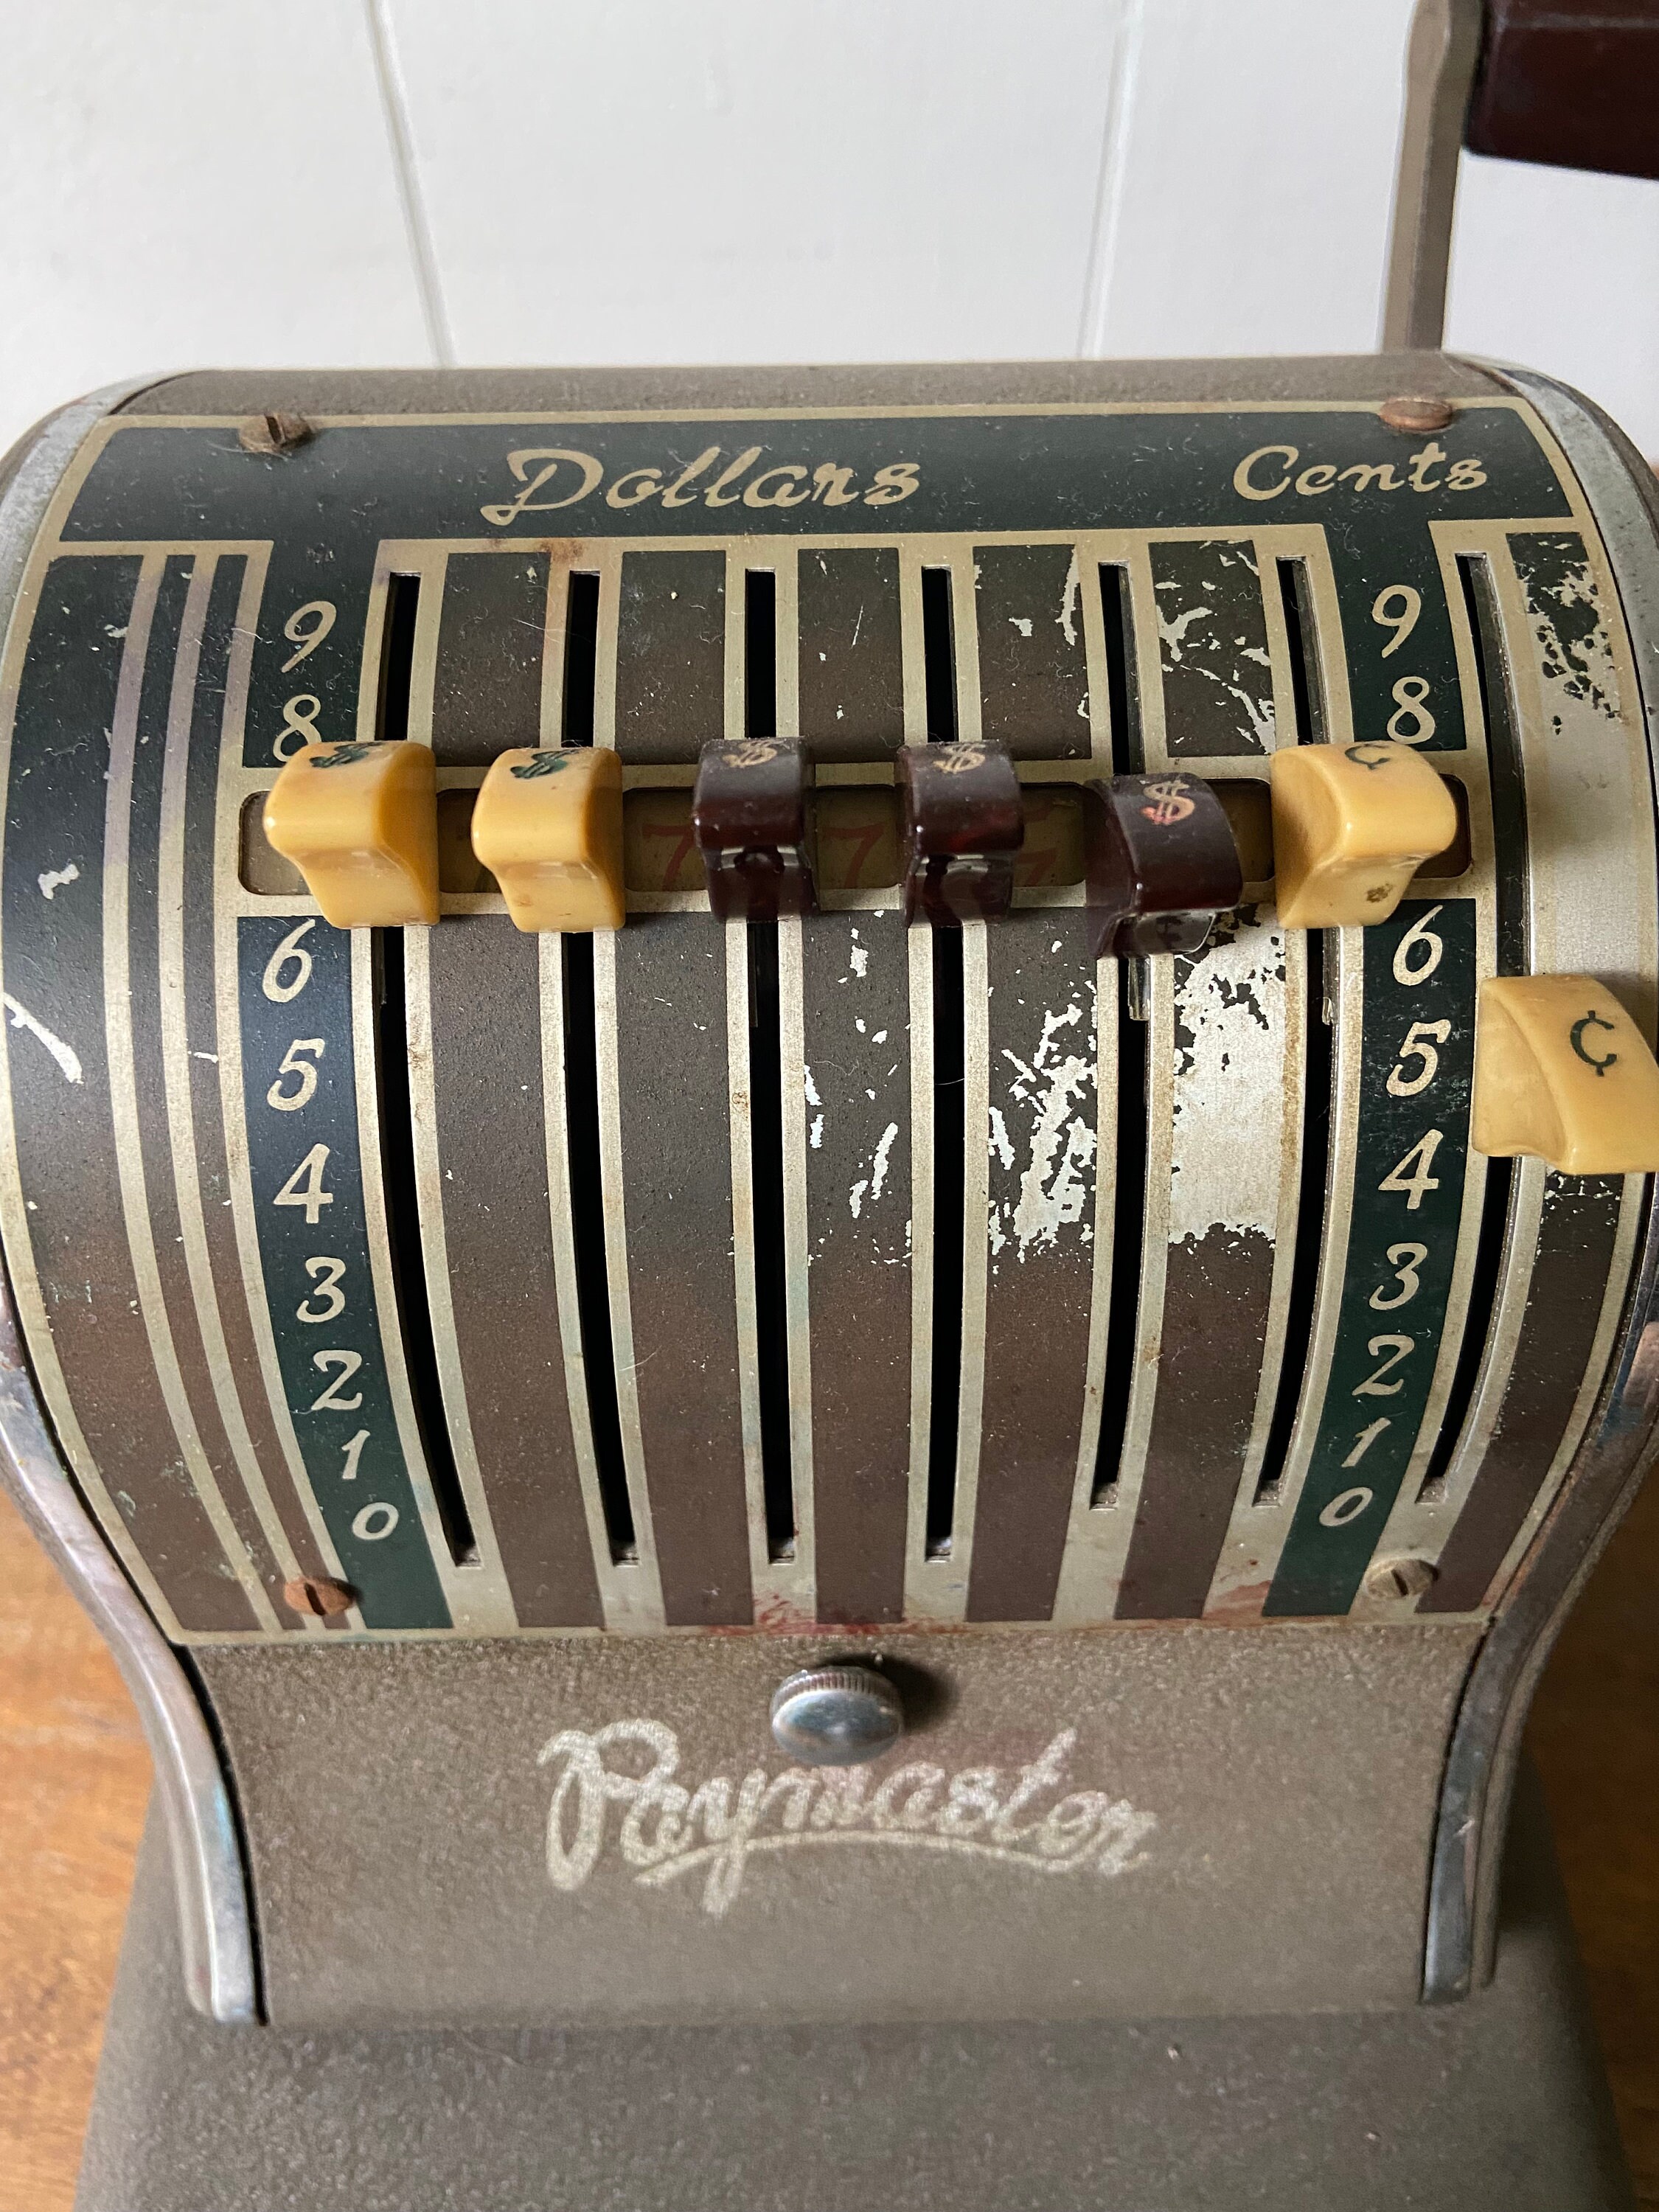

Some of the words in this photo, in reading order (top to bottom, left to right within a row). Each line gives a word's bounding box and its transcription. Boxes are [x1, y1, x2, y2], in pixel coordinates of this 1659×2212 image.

[480, 445, 920, 526] Dollars
[1233, 442, 1487, 501] Cents
[281, 600, 337, 673] 9
[1371, 584, 1422, 658] 9
[272, 694, 321, 762] 8
[1387, 676, 1436, 744] 8
[1141, 779, 1195, 826] $
[641, 824, 696, 891] 7
[824, 824, 886, 889] 7
[262, 919, 316, 1003] 6
[1392, 905, 1443, 986] 6
[266, 1038, 325, 1111] 5
[1385, 1019, 1452, 1096] 5
[274, 1143, 333, 1224] 4
[1377, 1129, 1444, 1210] 4
[296, 1256, 346, 1323] 3
[1368, 1242, 1427, 1310] 3
[311, 1349, 362, 1411] 2
[1352, 1335, 1415, 1396] 2
[341, 1429, 371, 1480] 1
[1340, 1417, 1391, 1467] 1
[352, 1502, 399, 1540] 0
[1318, 1486, 1374, 1526] 0
[537, 1718, 1158, 1916] Paymaster
